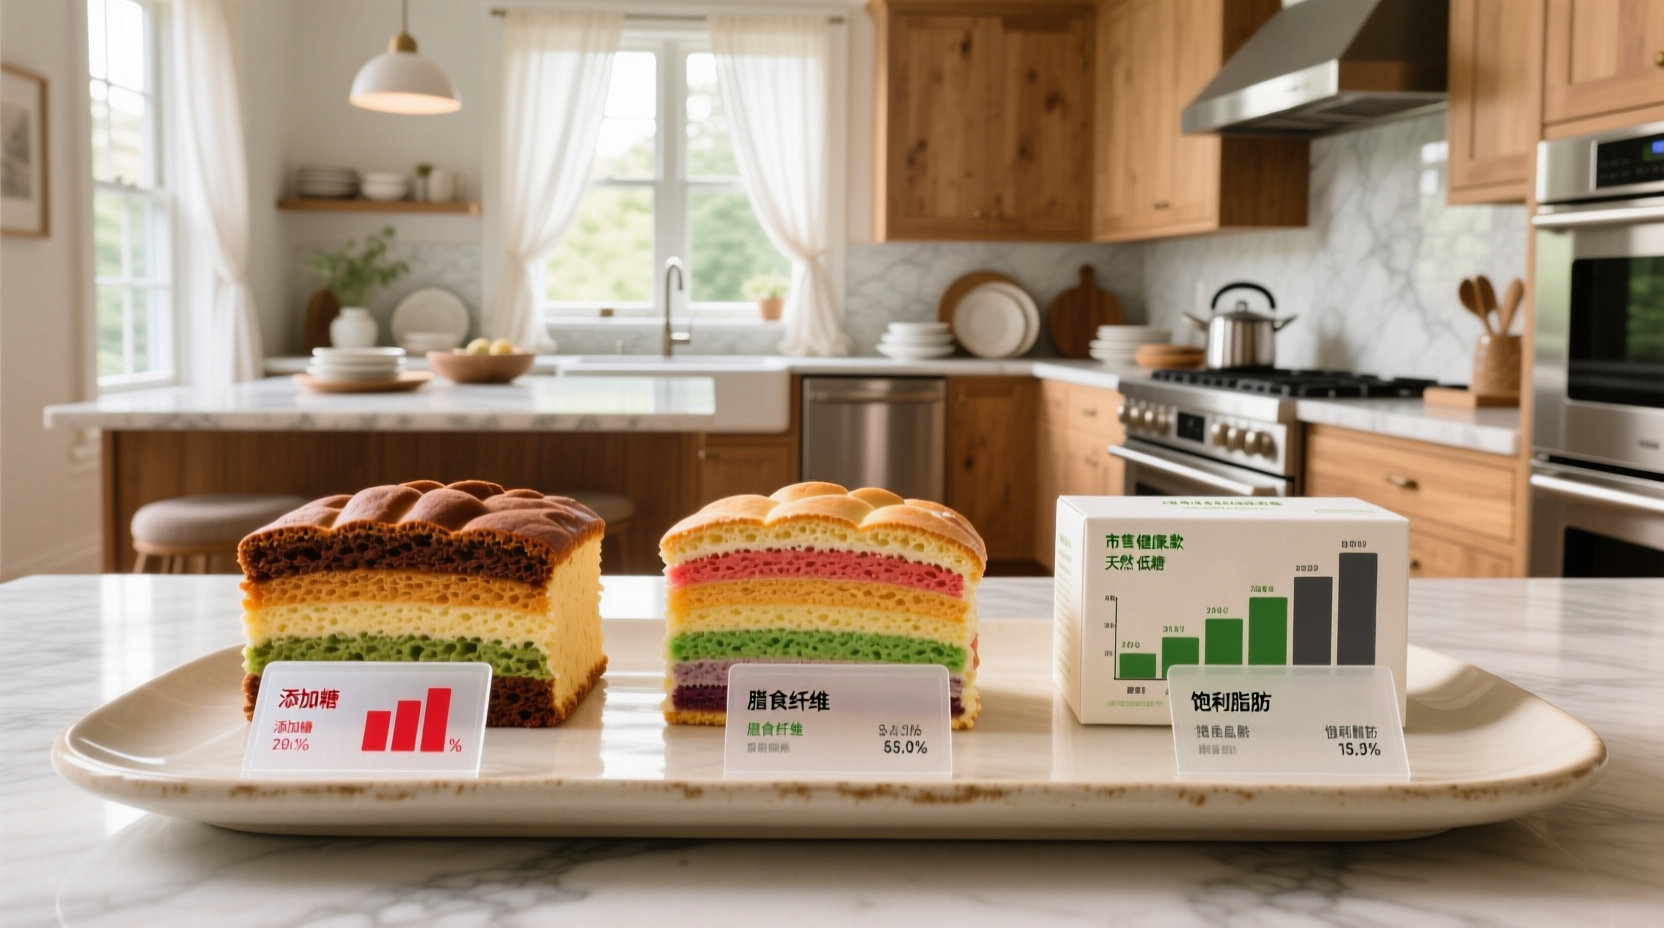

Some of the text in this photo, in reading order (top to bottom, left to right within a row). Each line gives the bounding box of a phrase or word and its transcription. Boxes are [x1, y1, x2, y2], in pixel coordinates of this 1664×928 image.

[278, 687, 341, 710] 添加糖
[1190, 690, 1272, 713] 饱利脂肪
